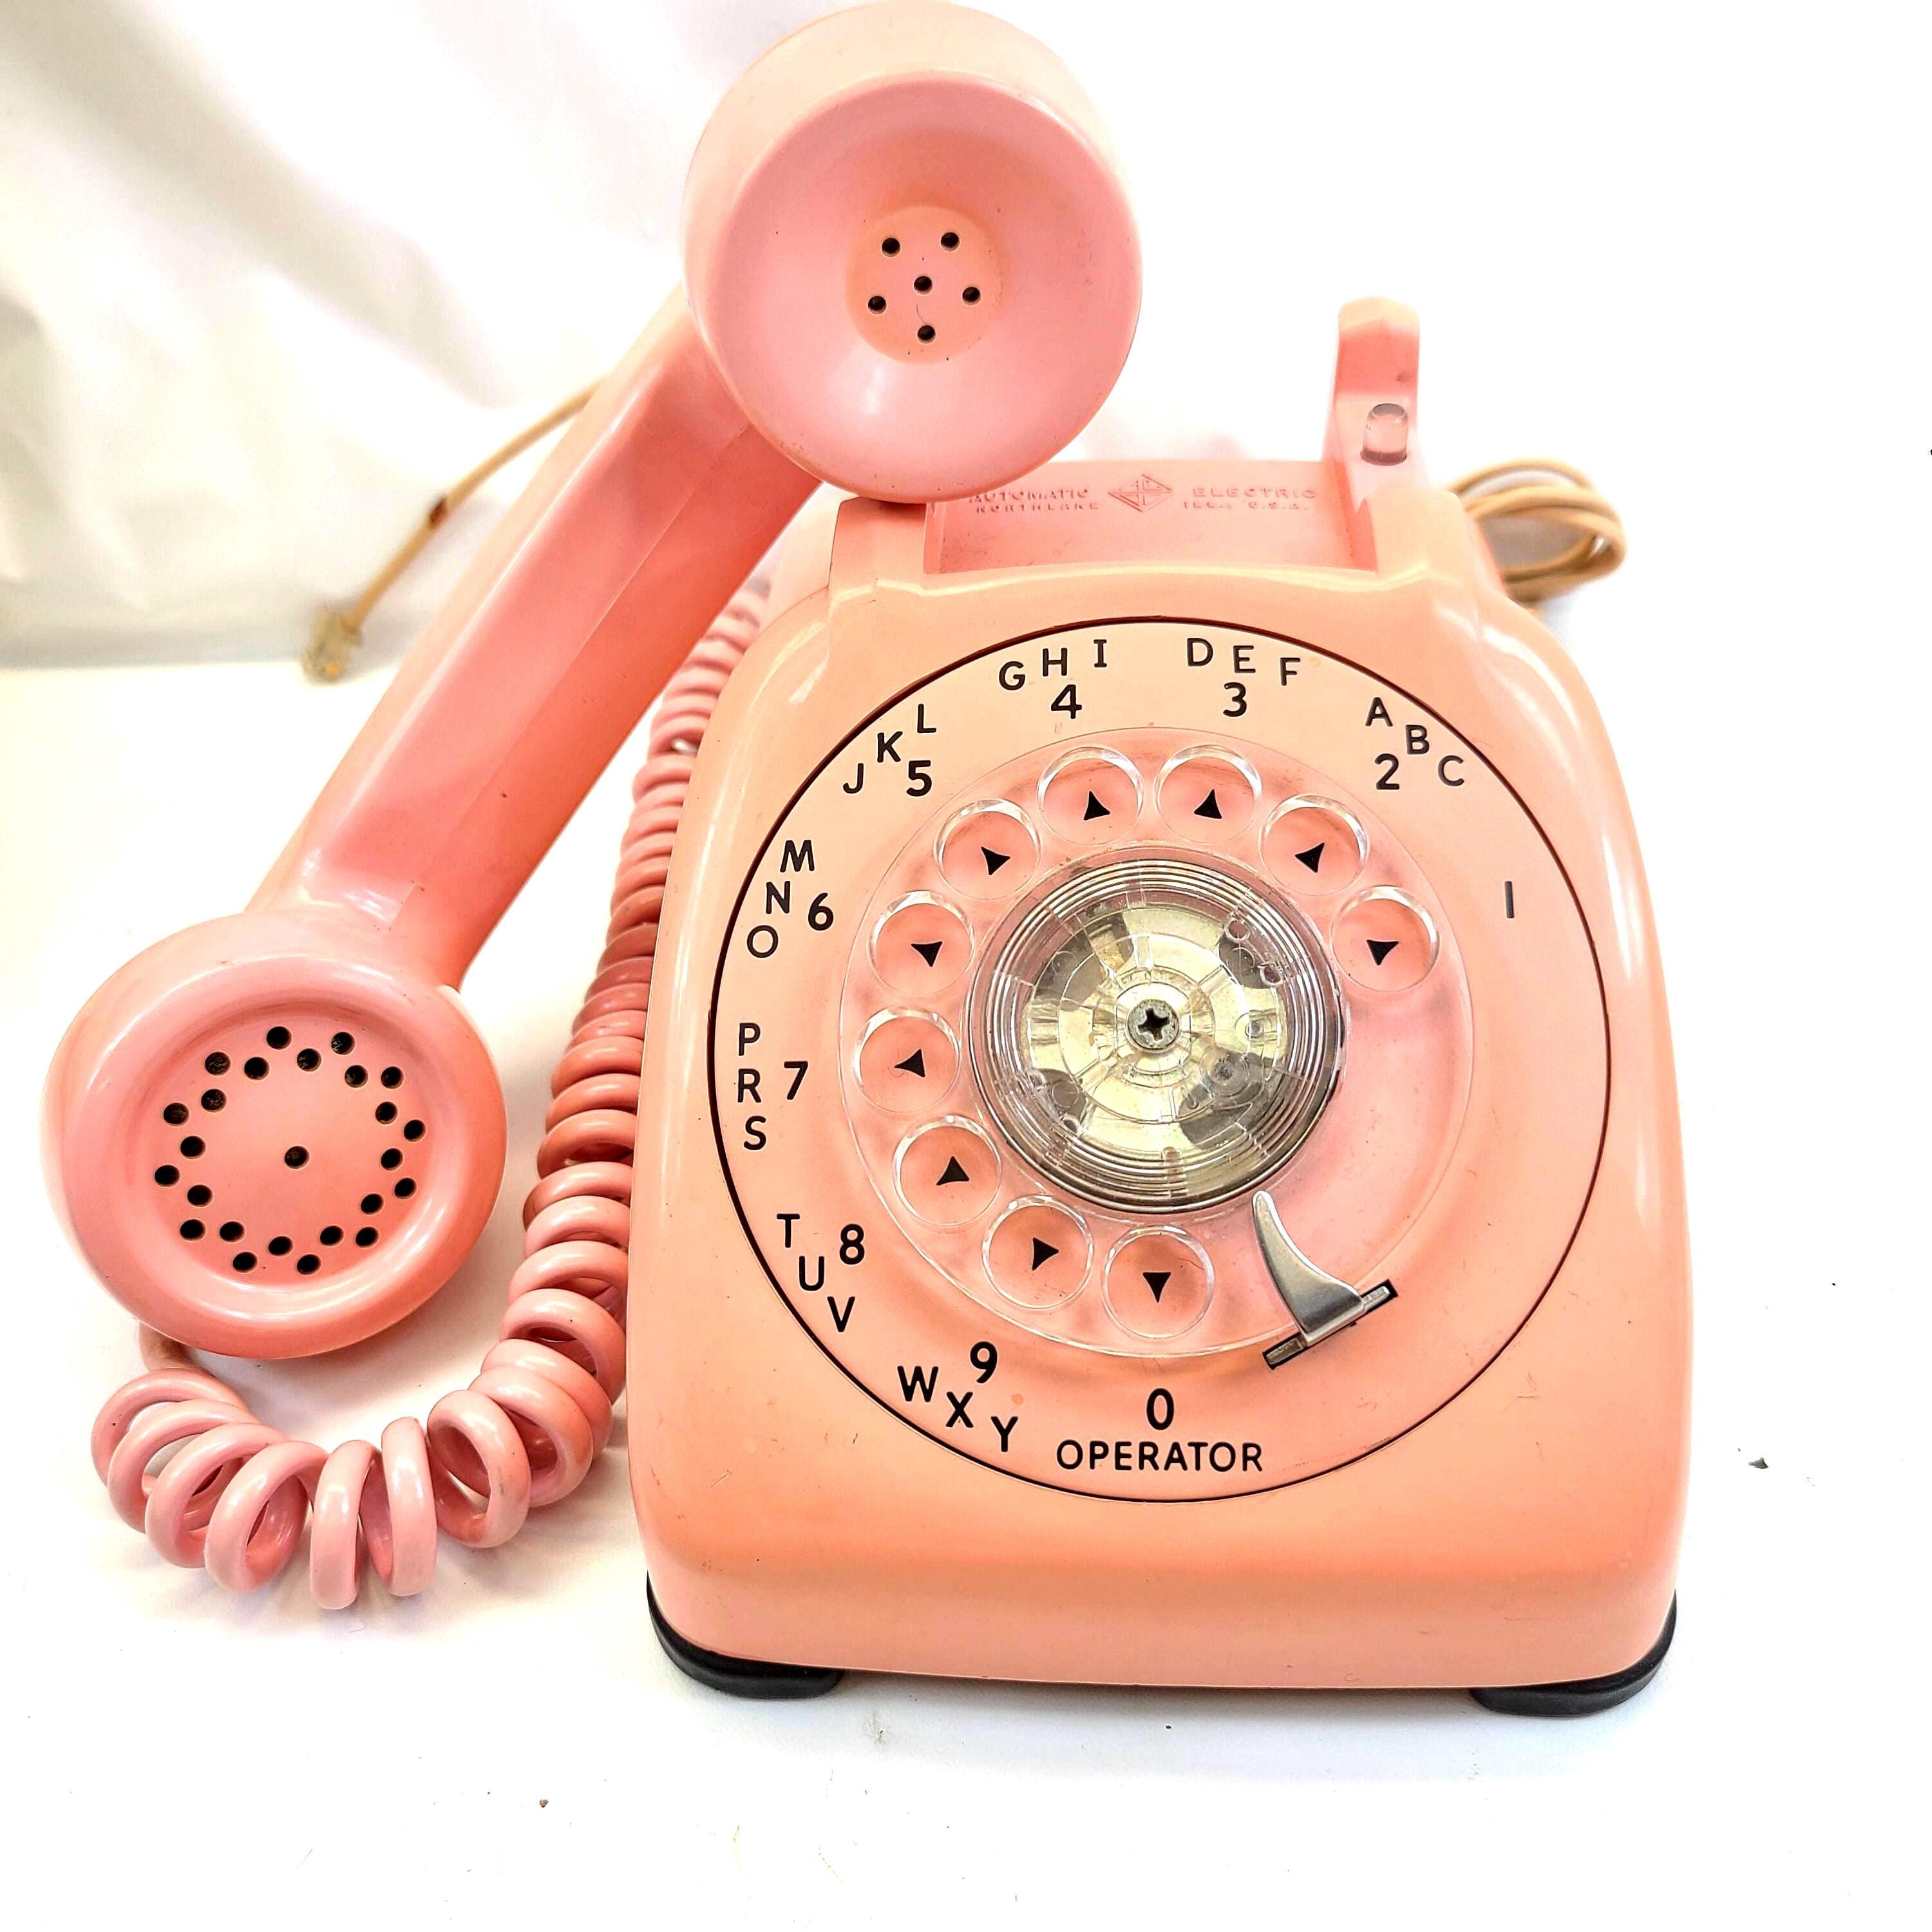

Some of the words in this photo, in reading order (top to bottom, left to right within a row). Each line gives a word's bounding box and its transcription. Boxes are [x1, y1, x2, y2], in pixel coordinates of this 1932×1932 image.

[969, 488, 1089, 504] AUTOMATIC
[1193, 488, 1316, 499] ELECTRIC
[976, 496, 1099, 514] NORTHLAKE
[1050, 684, 1083, 719] 4
[1223, 681, 1247, 717] 3
[906, 759, 933, 797] 5
[1374, 753, 1400, 790] 2
[808, 893, 834, 931] 6
[784, 1061, 808, 1101] 7
[839, 1223, 865, 1265] 8
[970, 1341, 998, 1384] 9
[1146, 1388, 1175, 1430] 0
[1056, 1439, 1263, 1472] OPERATOR
